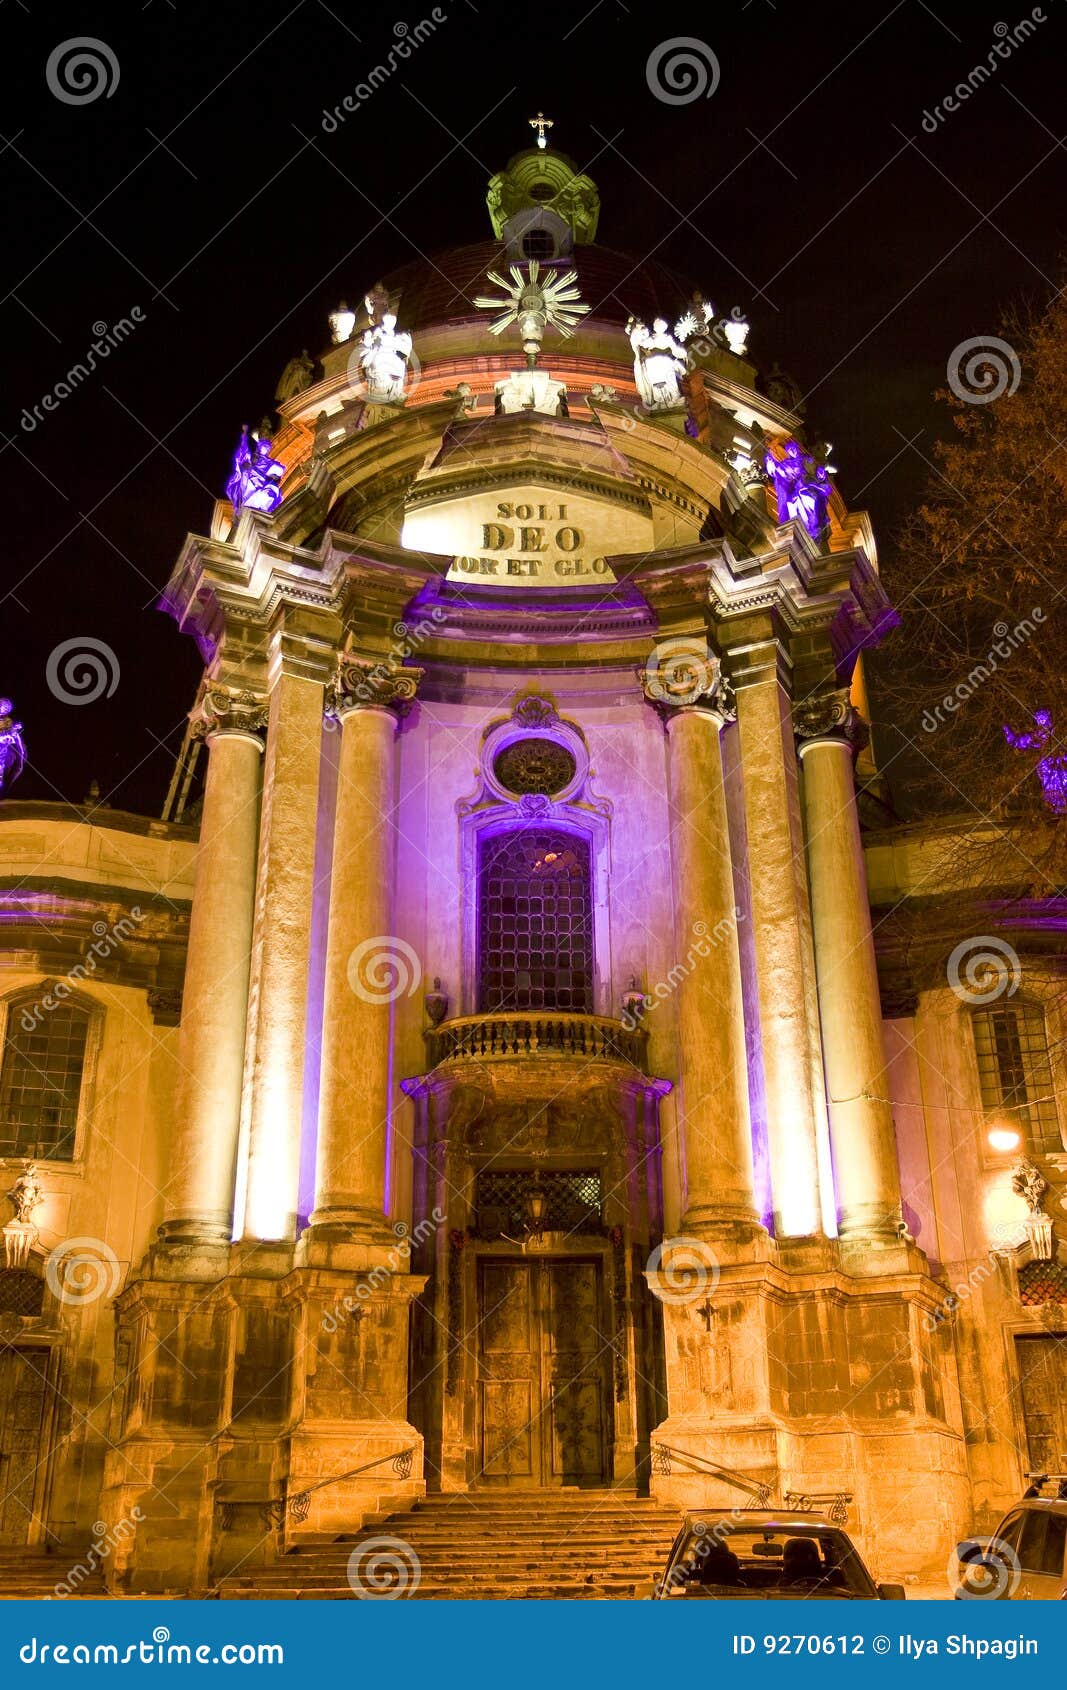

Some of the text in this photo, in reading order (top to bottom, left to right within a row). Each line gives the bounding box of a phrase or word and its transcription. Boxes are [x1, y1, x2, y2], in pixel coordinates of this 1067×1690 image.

[497, 502, 569, 520] SOLI
[480, 522, 585, 552] DEO
[505, 558, 542, 576] ET
[554, 557, 609, 576] GLO
